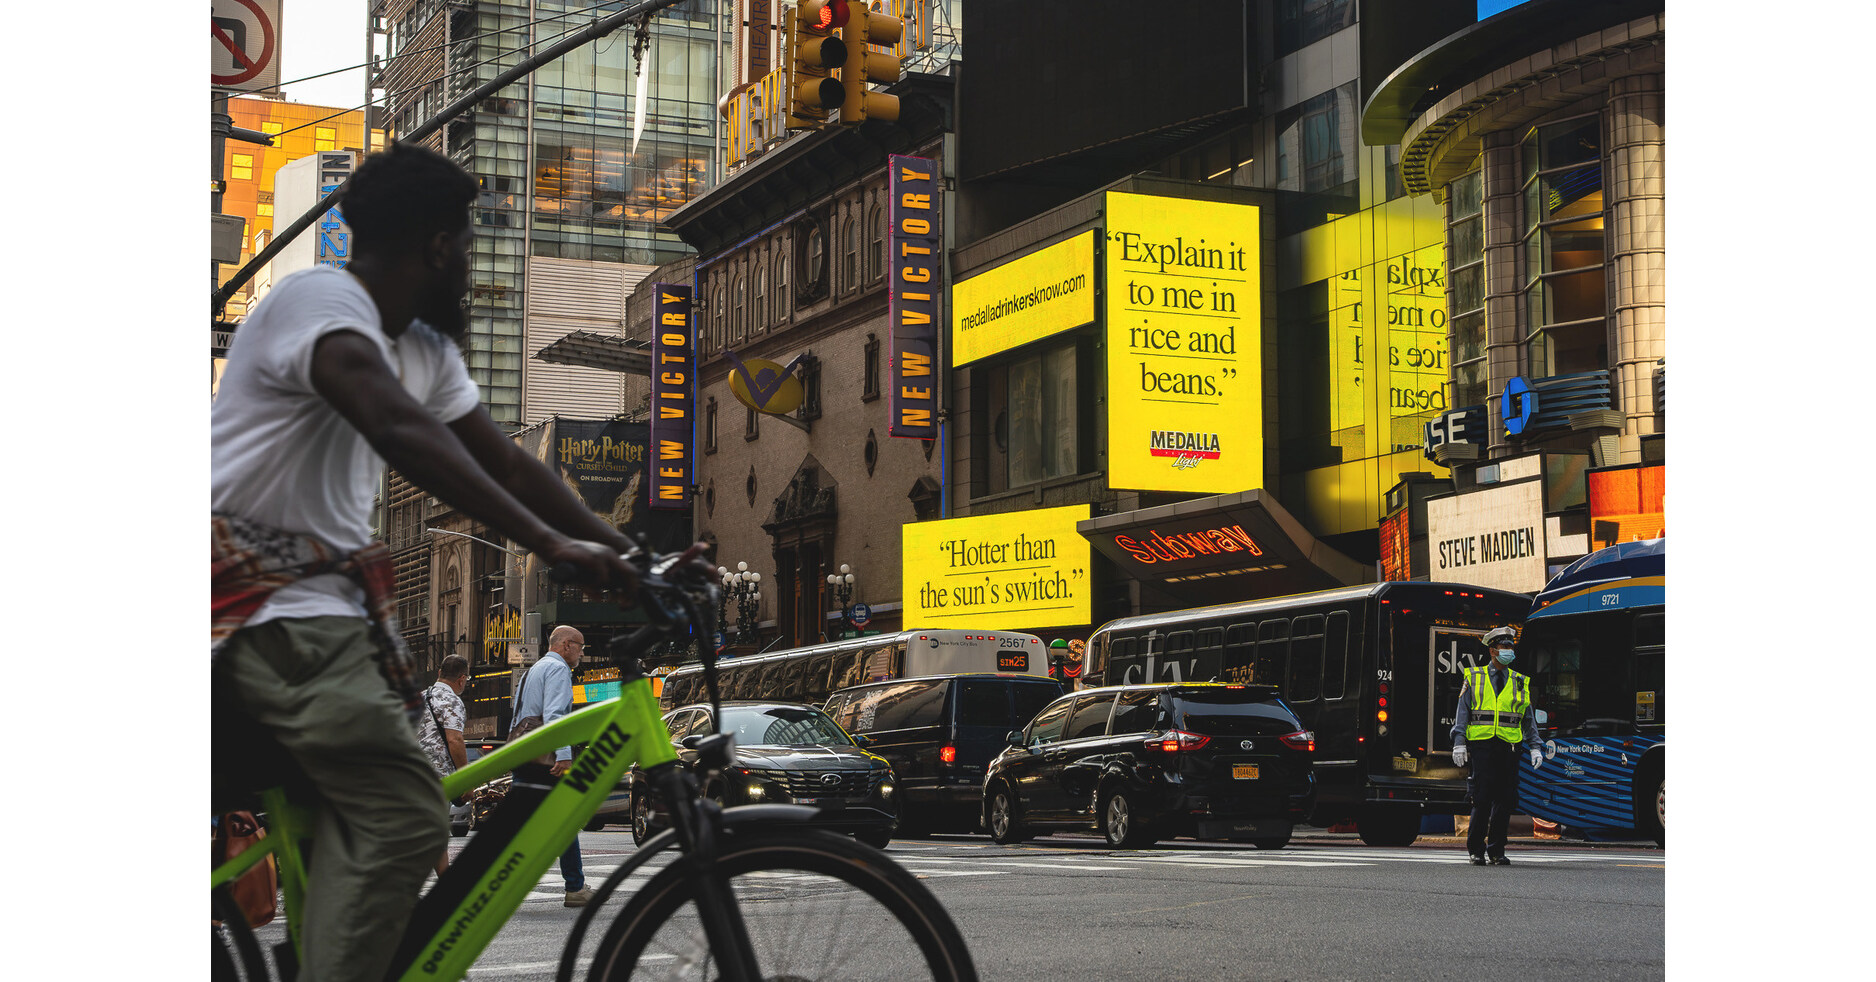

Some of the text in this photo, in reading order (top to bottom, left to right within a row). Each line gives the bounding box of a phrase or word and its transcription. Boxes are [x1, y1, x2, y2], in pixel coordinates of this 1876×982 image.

[752, 0, 768, 70] THEATR
[728, 66, 782, 167] NEW
[1106, 231, 1247, 273] “Explain it
[902, 167, 931, 427] NEW VICTORY
[961, 271, 1086, 332] medalladrinkersknow.com
[1128, 280, 1237, 313] to me in
[1129, 319, 1237, 355] rice and
[659, 292, 686, 499] NEW VICTORY
[1139, 362, 1237, 397] beans.”
[558, 436, 644, 468] Harry Potter
[1150, 430, 1221, 452] MEDALLA
[576, 462, 628, 472] CURSED CHILD
[591, 475, 624, 483] BROADWAY
[1171, 452, 1203, 471] Light
[939, 533, 1057, 568] “Hotter than
[1115, 525, 1263, 564] Subway
[1439, 526, 1535, 569] STEVE MADDEN
[920, 581, 948, 609] the
[1005, 568, 1084, 603] switch.”
[1601, 593, 1620, 606] 9721
[1000, 637, 1026, 648] 2567
[1000, 656, 1026, 667] SIM25
[1377, 669, 1393, 681] 924
[1440, 717, 1457, 725] #LV
[563, 721, 631, 794] WHIZZ
[1556, 745, 1569, 753] New
[1569, 745, 1581, 753] York
[1582, 744, 1593, 754] City
[1593, 744, 1605, 753] Bus
[422, 851, 525, 976] getwhizz.com
